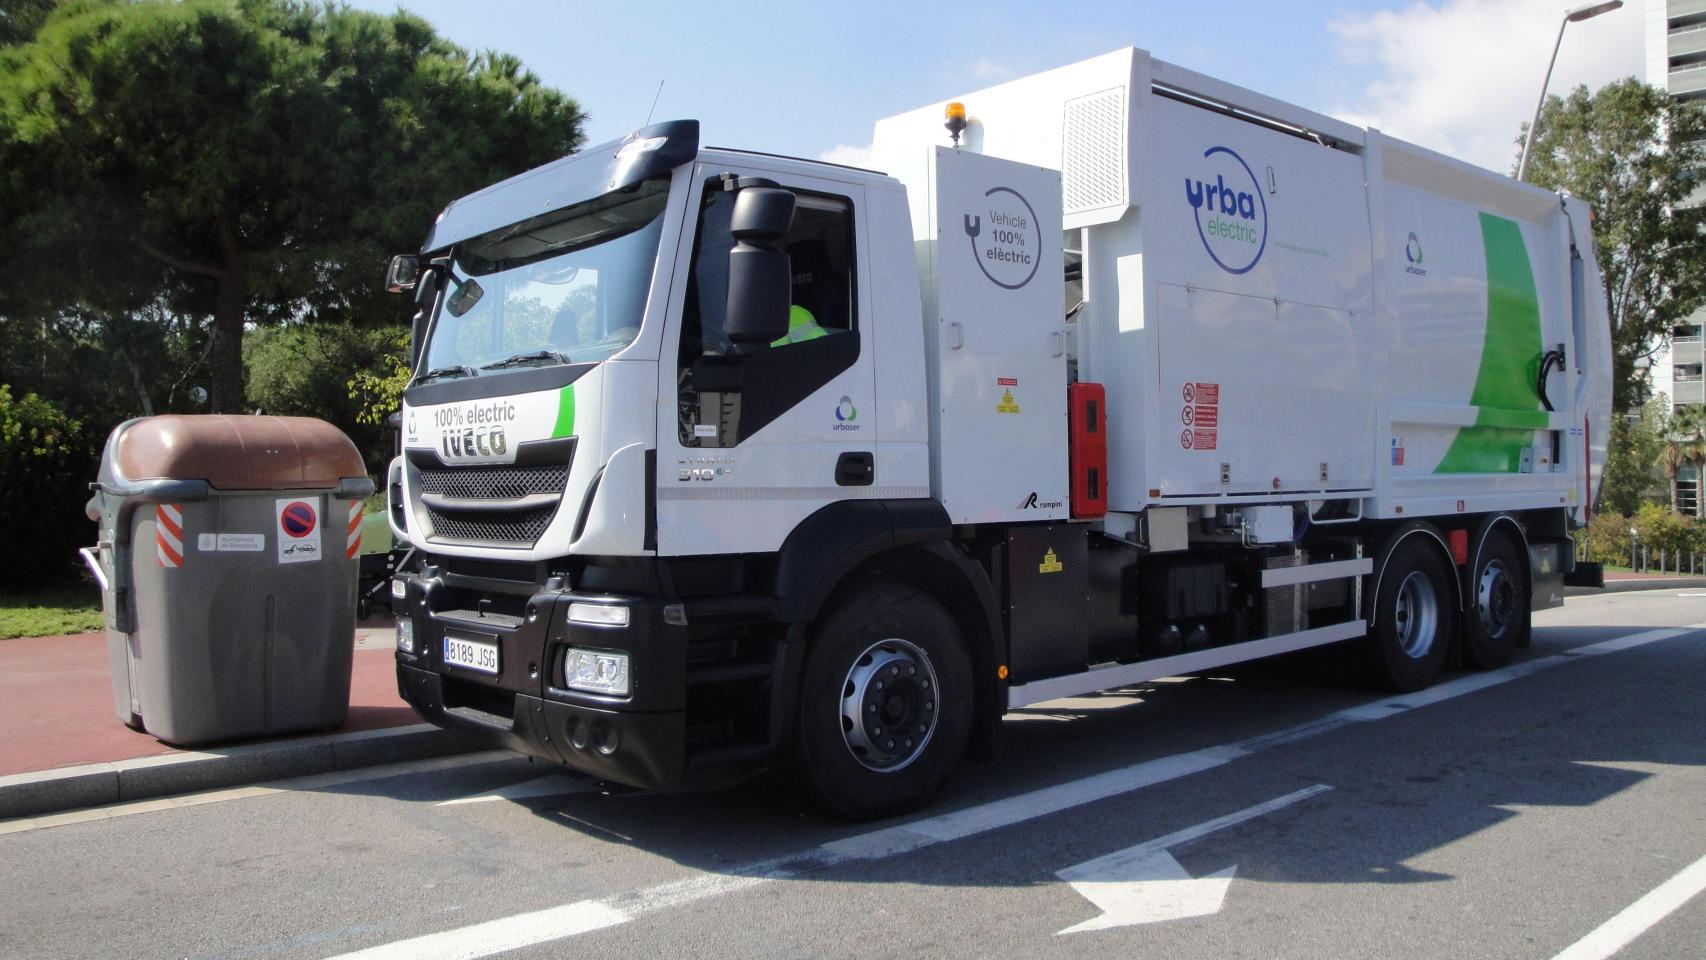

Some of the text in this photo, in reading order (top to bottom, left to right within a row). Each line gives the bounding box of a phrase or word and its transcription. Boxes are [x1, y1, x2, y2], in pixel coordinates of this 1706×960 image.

[1185, 174, 1256, 220] urba
[989, 210, 1027, 229] Vehicle
[1207, 216, 1257, 244] electric
[992, 229, 1025, 246] 100%
[434, 401, 515, 428] 100% electric
[832, 423, 861, 431] urbaser
[442, 424, 507, 458] IVECO
[1040, 500, 1063, 509] rampini
[450, 641, 495, 668] 8189 JSG
